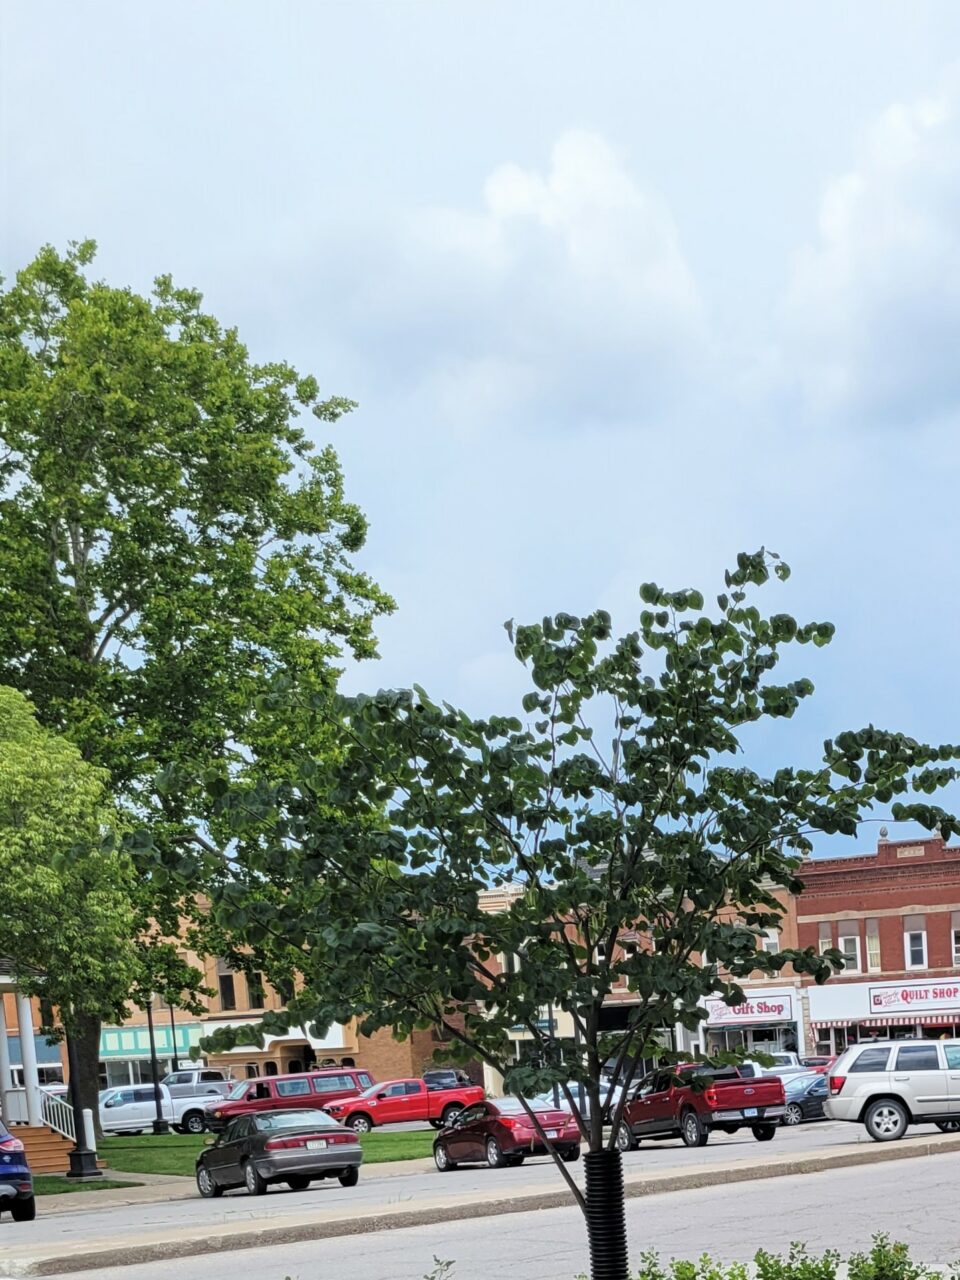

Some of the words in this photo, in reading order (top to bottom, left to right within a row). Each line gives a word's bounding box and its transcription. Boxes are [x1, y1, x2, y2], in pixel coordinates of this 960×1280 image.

[901, 989, 930, 1004] QUILT
[932, 987, 959, 999] SHOP
[732, 1002, 755, 1015] Gift
[756, 1001, 784, 1015] Shop
